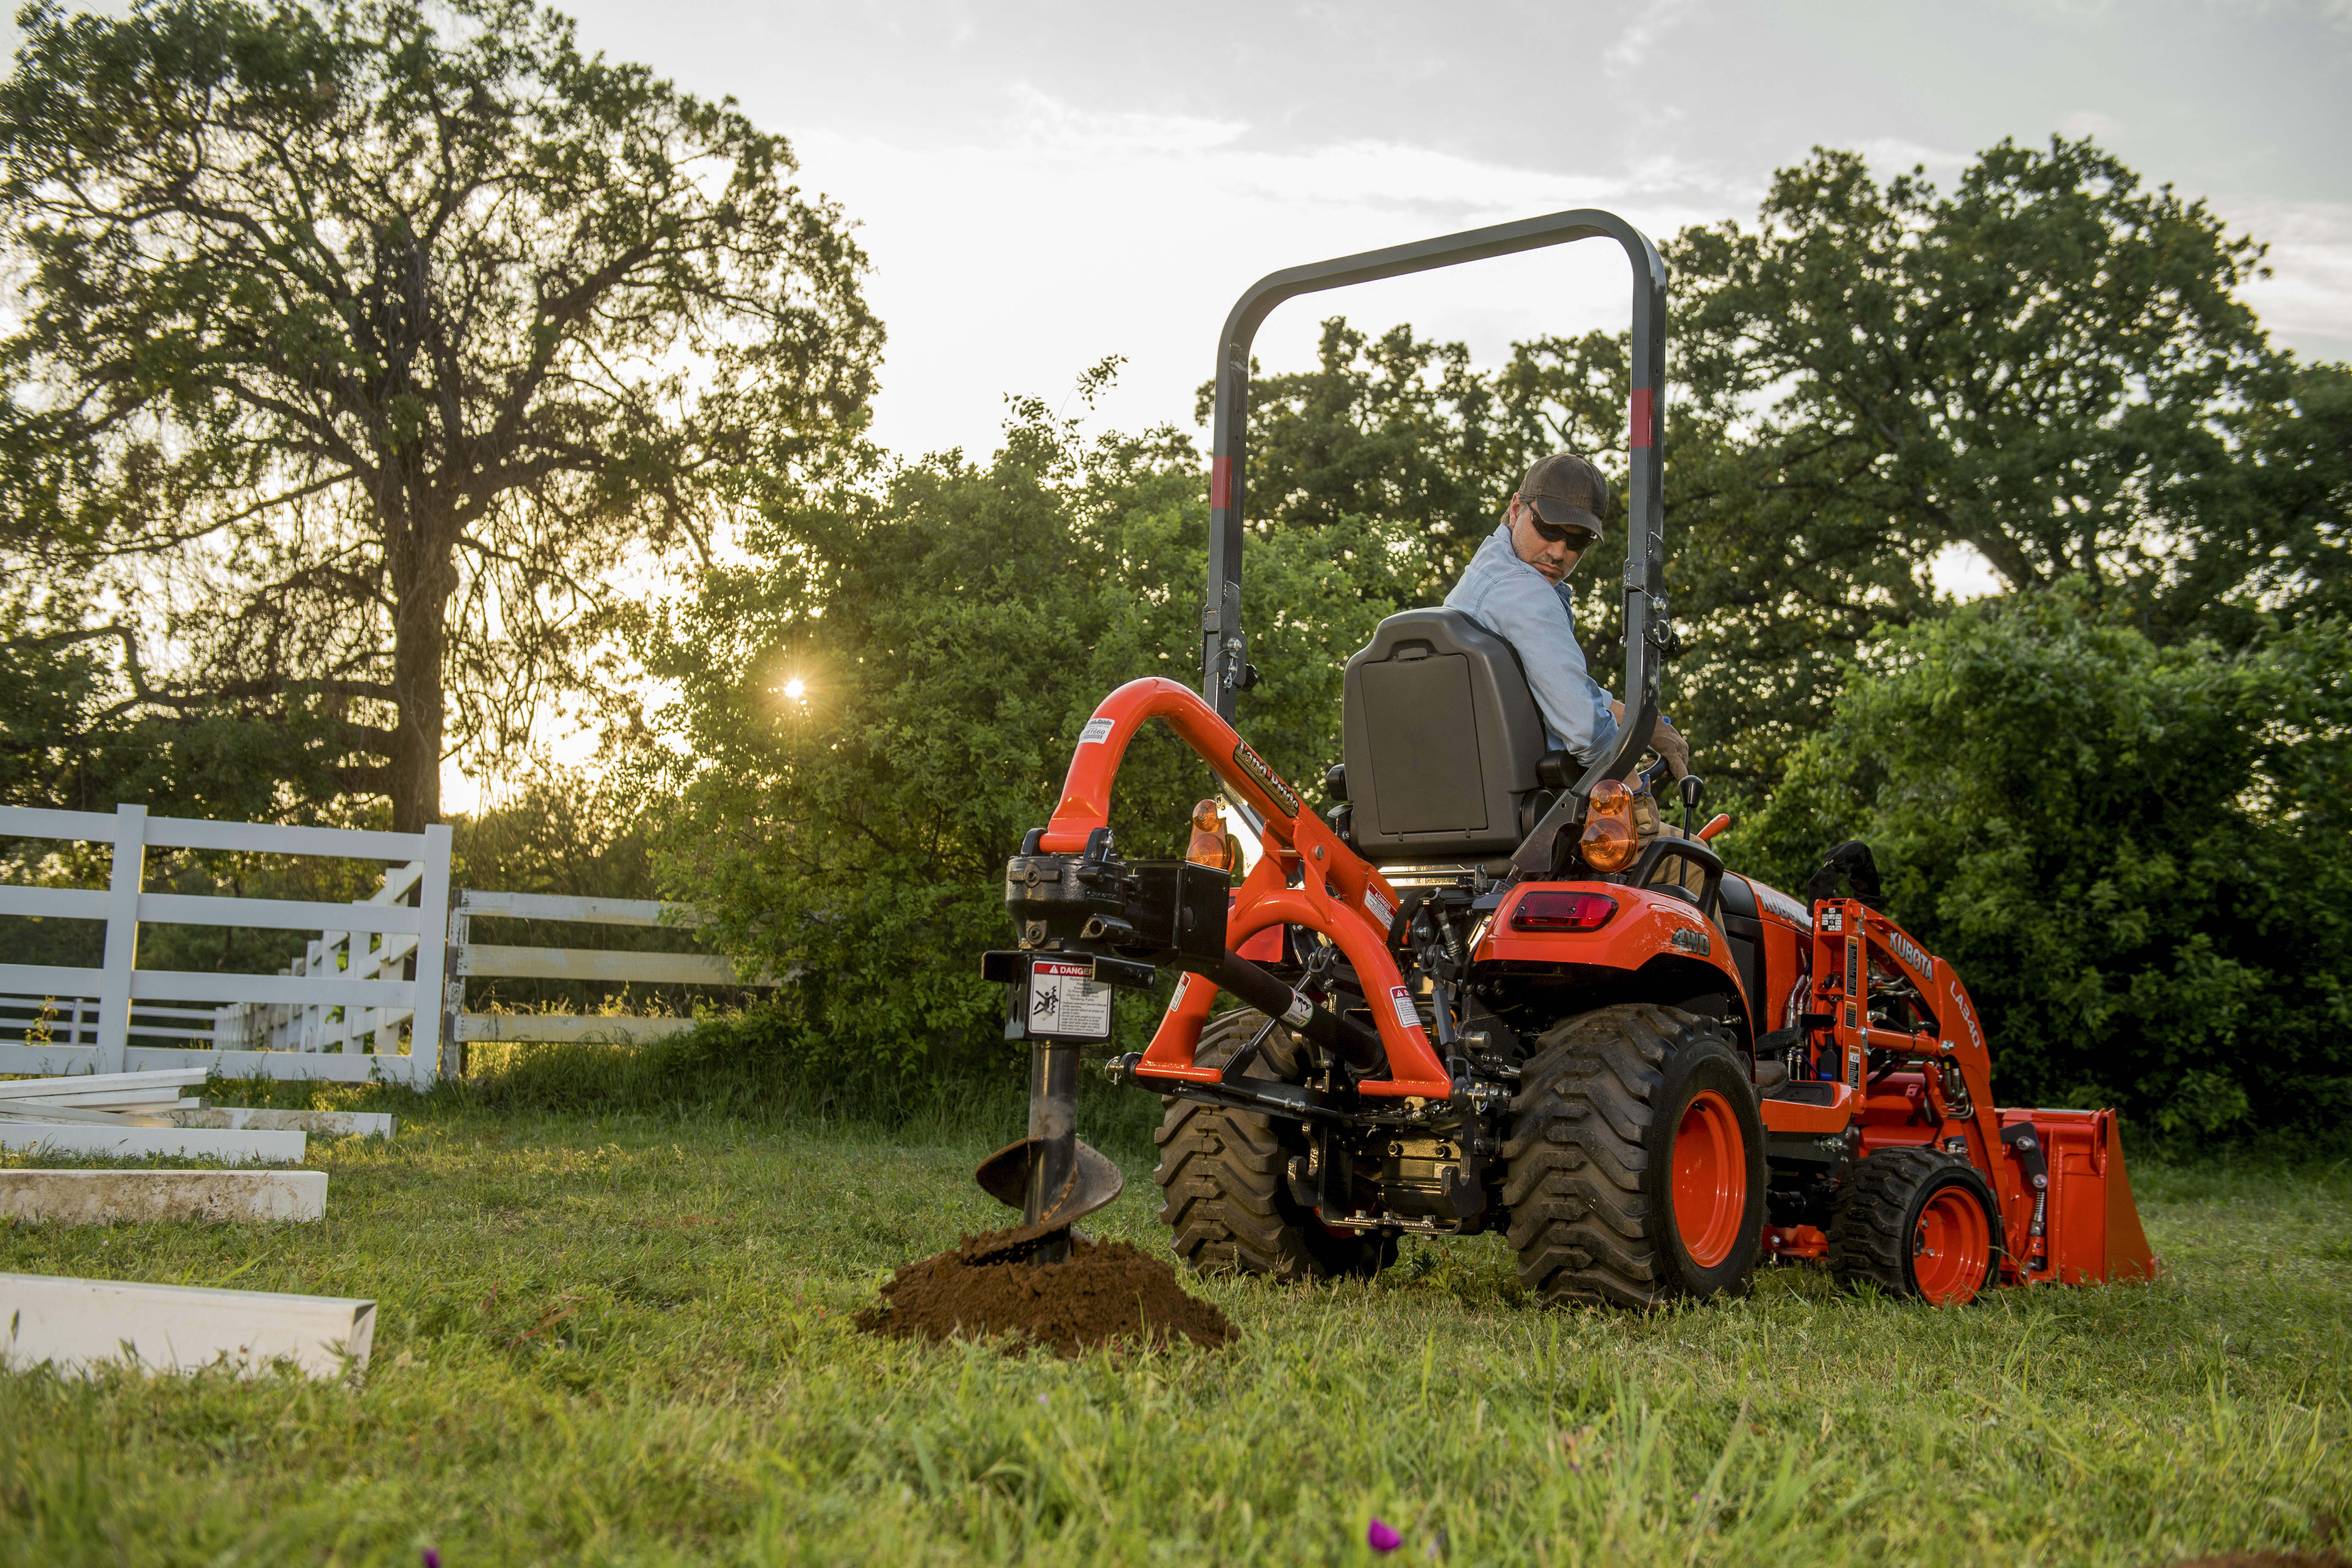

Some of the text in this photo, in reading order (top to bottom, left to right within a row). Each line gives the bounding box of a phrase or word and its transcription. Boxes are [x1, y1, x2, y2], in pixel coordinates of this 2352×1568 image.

[1237, 739, 1298, 811] Land Pride
[1377, 895, 1391, 911] DANGER
[1671, 927, 1710, 957] 4WD
[1889, 932, 1933, 983] KUBOTA
[1286, 1013, 1301, 1023] DANGER
[1950, 980, 1981, 1048] LA340
